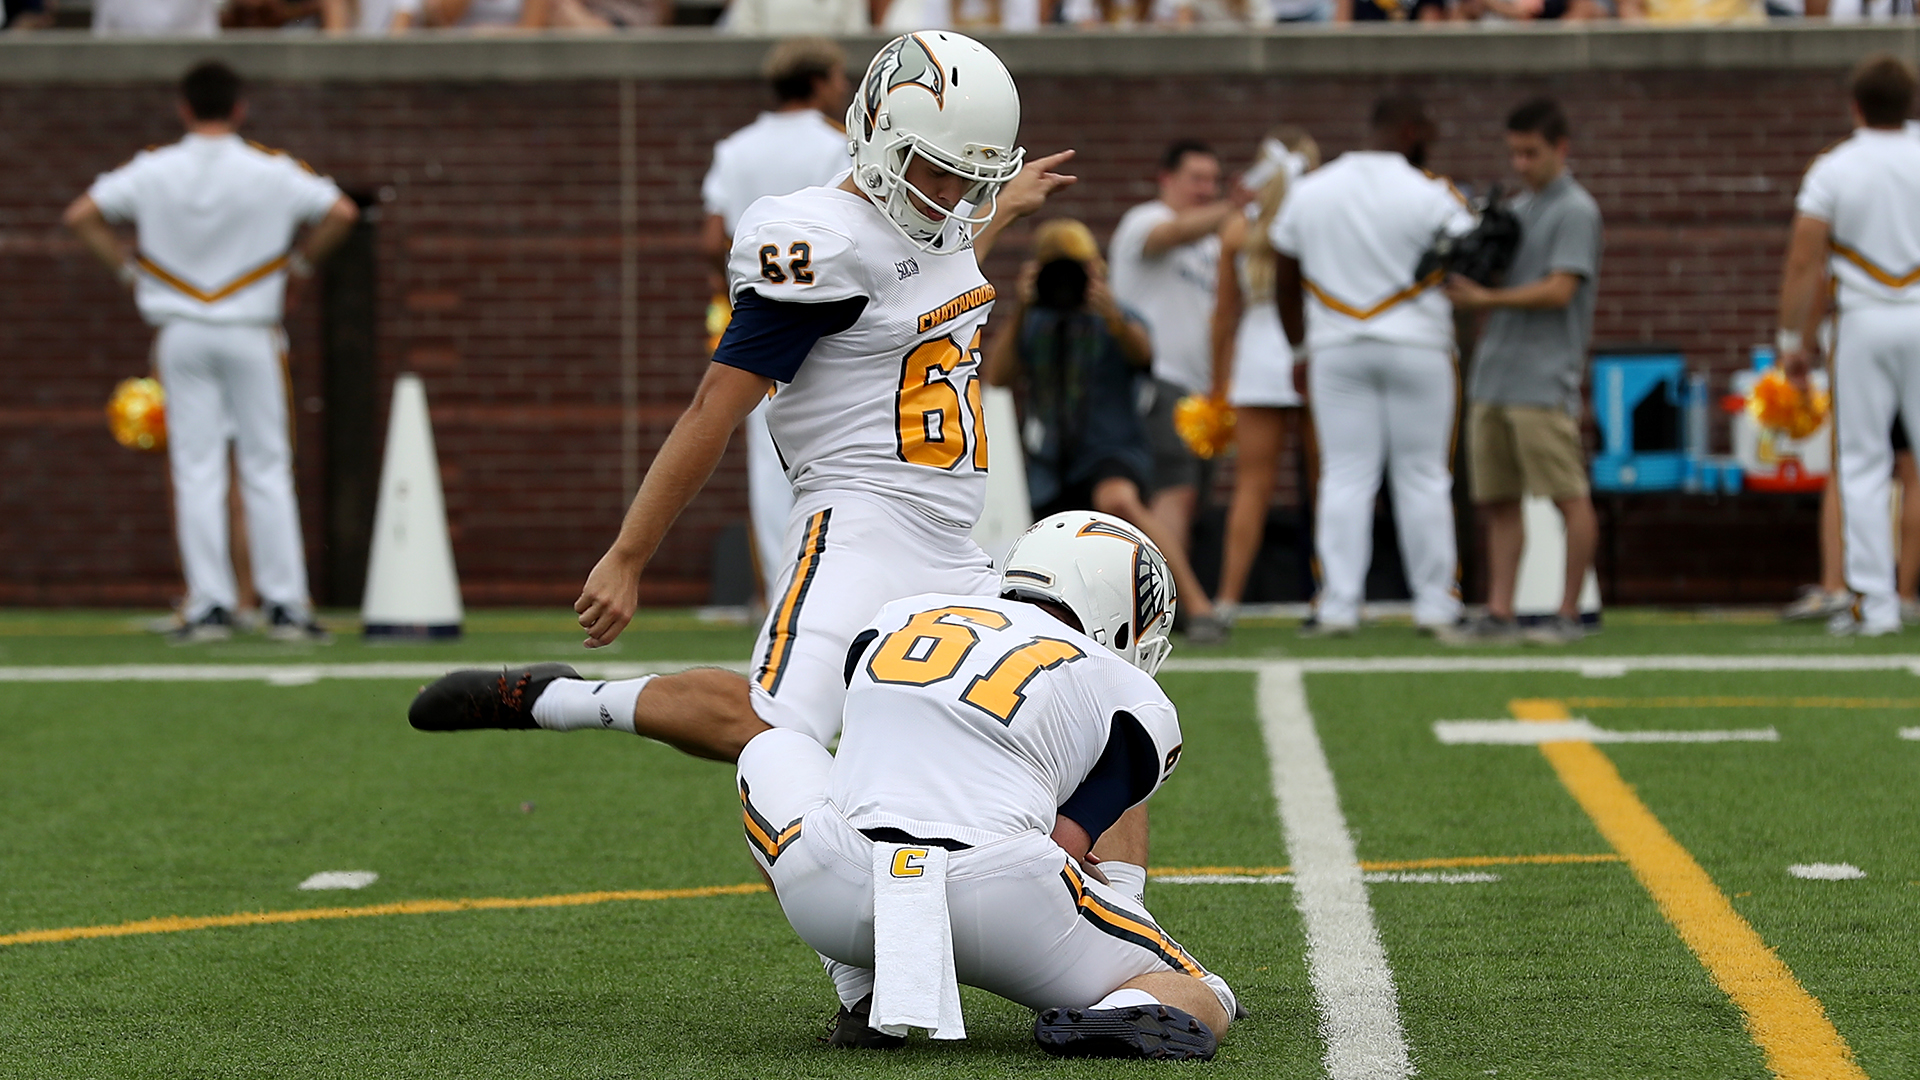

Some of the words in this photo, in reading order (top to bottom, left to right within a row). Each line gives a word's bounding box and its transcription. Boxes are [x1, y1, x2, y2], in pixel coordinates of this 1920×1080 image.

[759, 241, 814, 285] 62
[917, 283, 996, 333] CHATTANOOG
[866, 605, 1087, 727] 61
[890, 847, 929, 878] C
